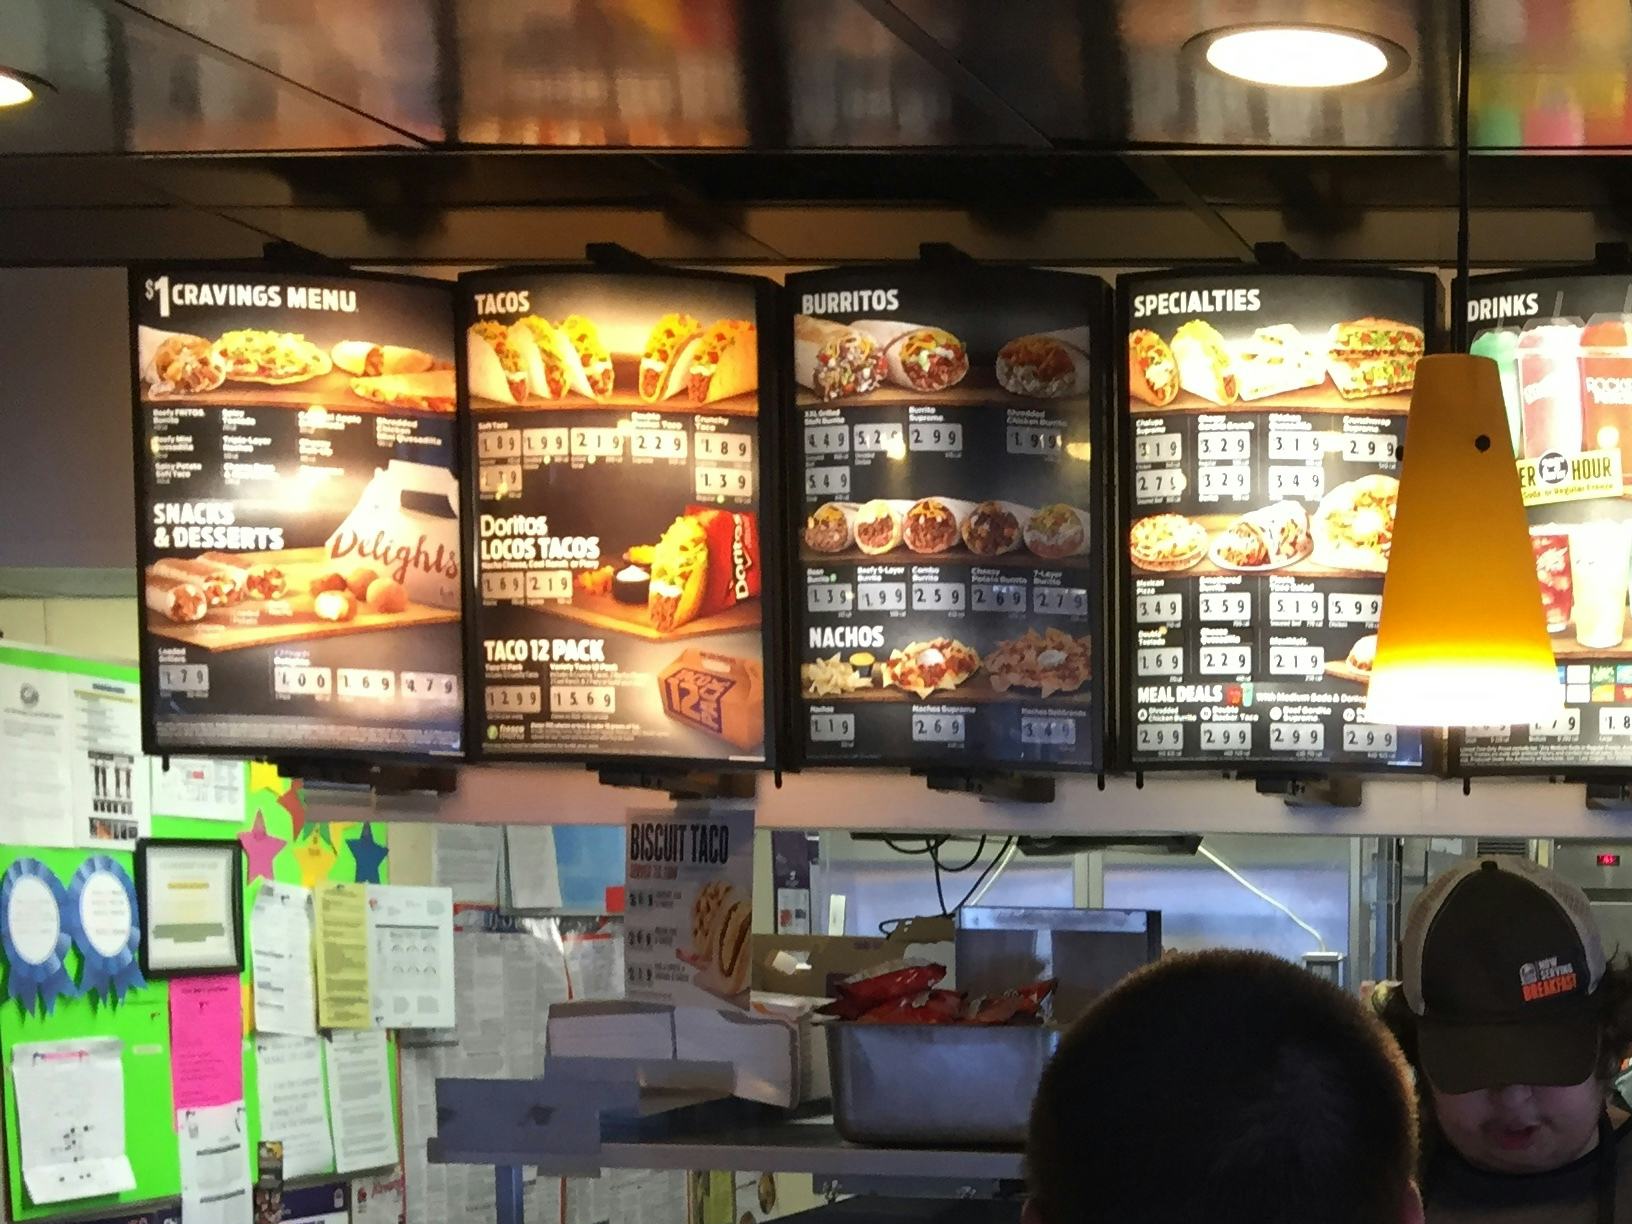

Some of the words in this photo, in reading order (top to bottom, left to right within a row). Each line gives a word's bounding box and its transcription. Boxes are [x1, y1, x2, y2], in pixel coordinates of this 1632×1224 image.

[172, 283, 281, 308] CRAVINGS
[287, 287, 357, 312] MENU
[474, 291, 530, 315] TACOS
[802, 289, 899, 315] BURRITOS
[1134, 288, 1261, 318] SPECIALTIES
[1467, 293, 1539, 322] DRINKS
[1572, 457, 1612, 481] HOUR
[153, 503, 235, 525] SNACKS
[480, 515, 548, 537] Doritos
[154, 527, 170, 548] &
[172, 527, 284, 549] DESSERTS
[481, 538, 536, 560] LOCOS
[537, 537, 600, 559] TACOS
[330, 531, 458, 583] Delights
[732, 513, 752, 600] Doritos
[809, 625, 884, 648] NACHOS
[484, 640, 528, 661] TACO
[530, 640, 550, 661] 12
[552, 639, 605, 661] PACK
[1137, 687, 1175, 702] MEAL
[1176, 685, 1223, 702] DEALS
[631, 824, 687, 862] BISCUIT
[690, 824, 729, 864] TACO
[1538, 957, 1557, 969] NOW
[1541, 964, 1573, 980] SERVING
[1521, 973, 1577, 1001] BREAKFAST
